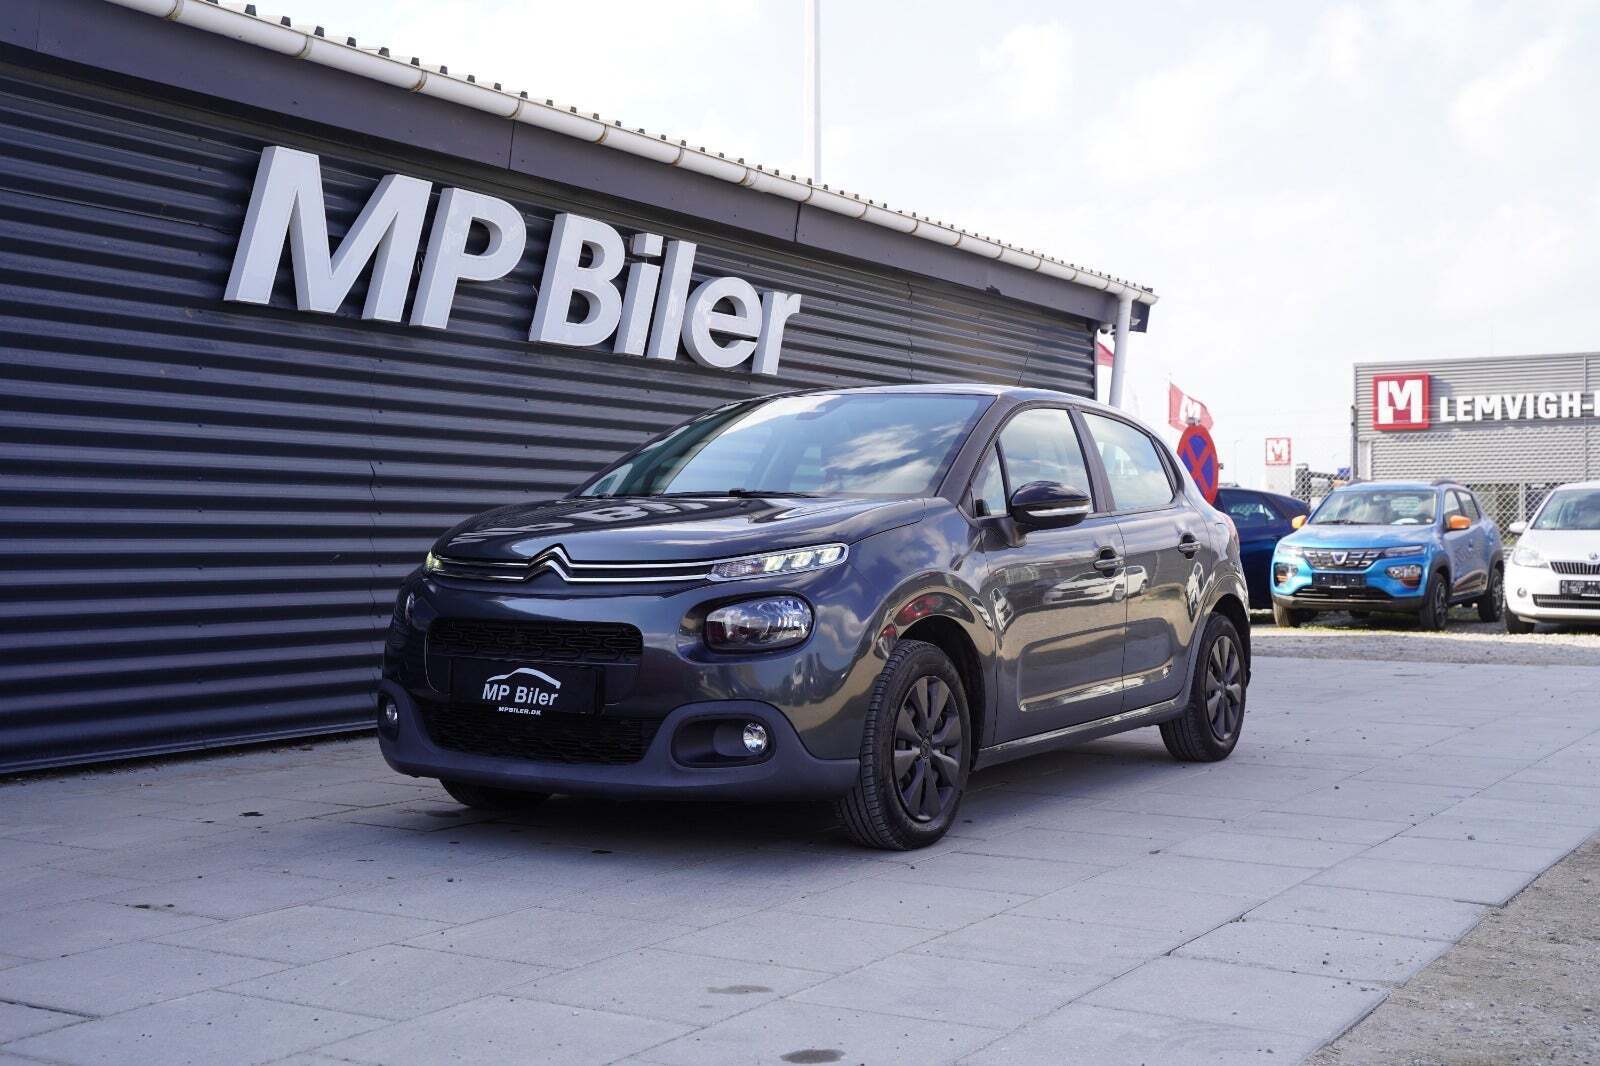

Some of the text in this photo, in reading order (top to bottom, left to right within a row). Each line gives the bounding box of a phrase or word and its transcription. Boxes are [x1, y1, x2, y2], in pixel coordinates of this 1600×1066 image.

[224, 146, 801, 375] MP Biler
[482, 683, 559, 706] MP Biler
[498, 706, 542, 716] MPBILER.DK
